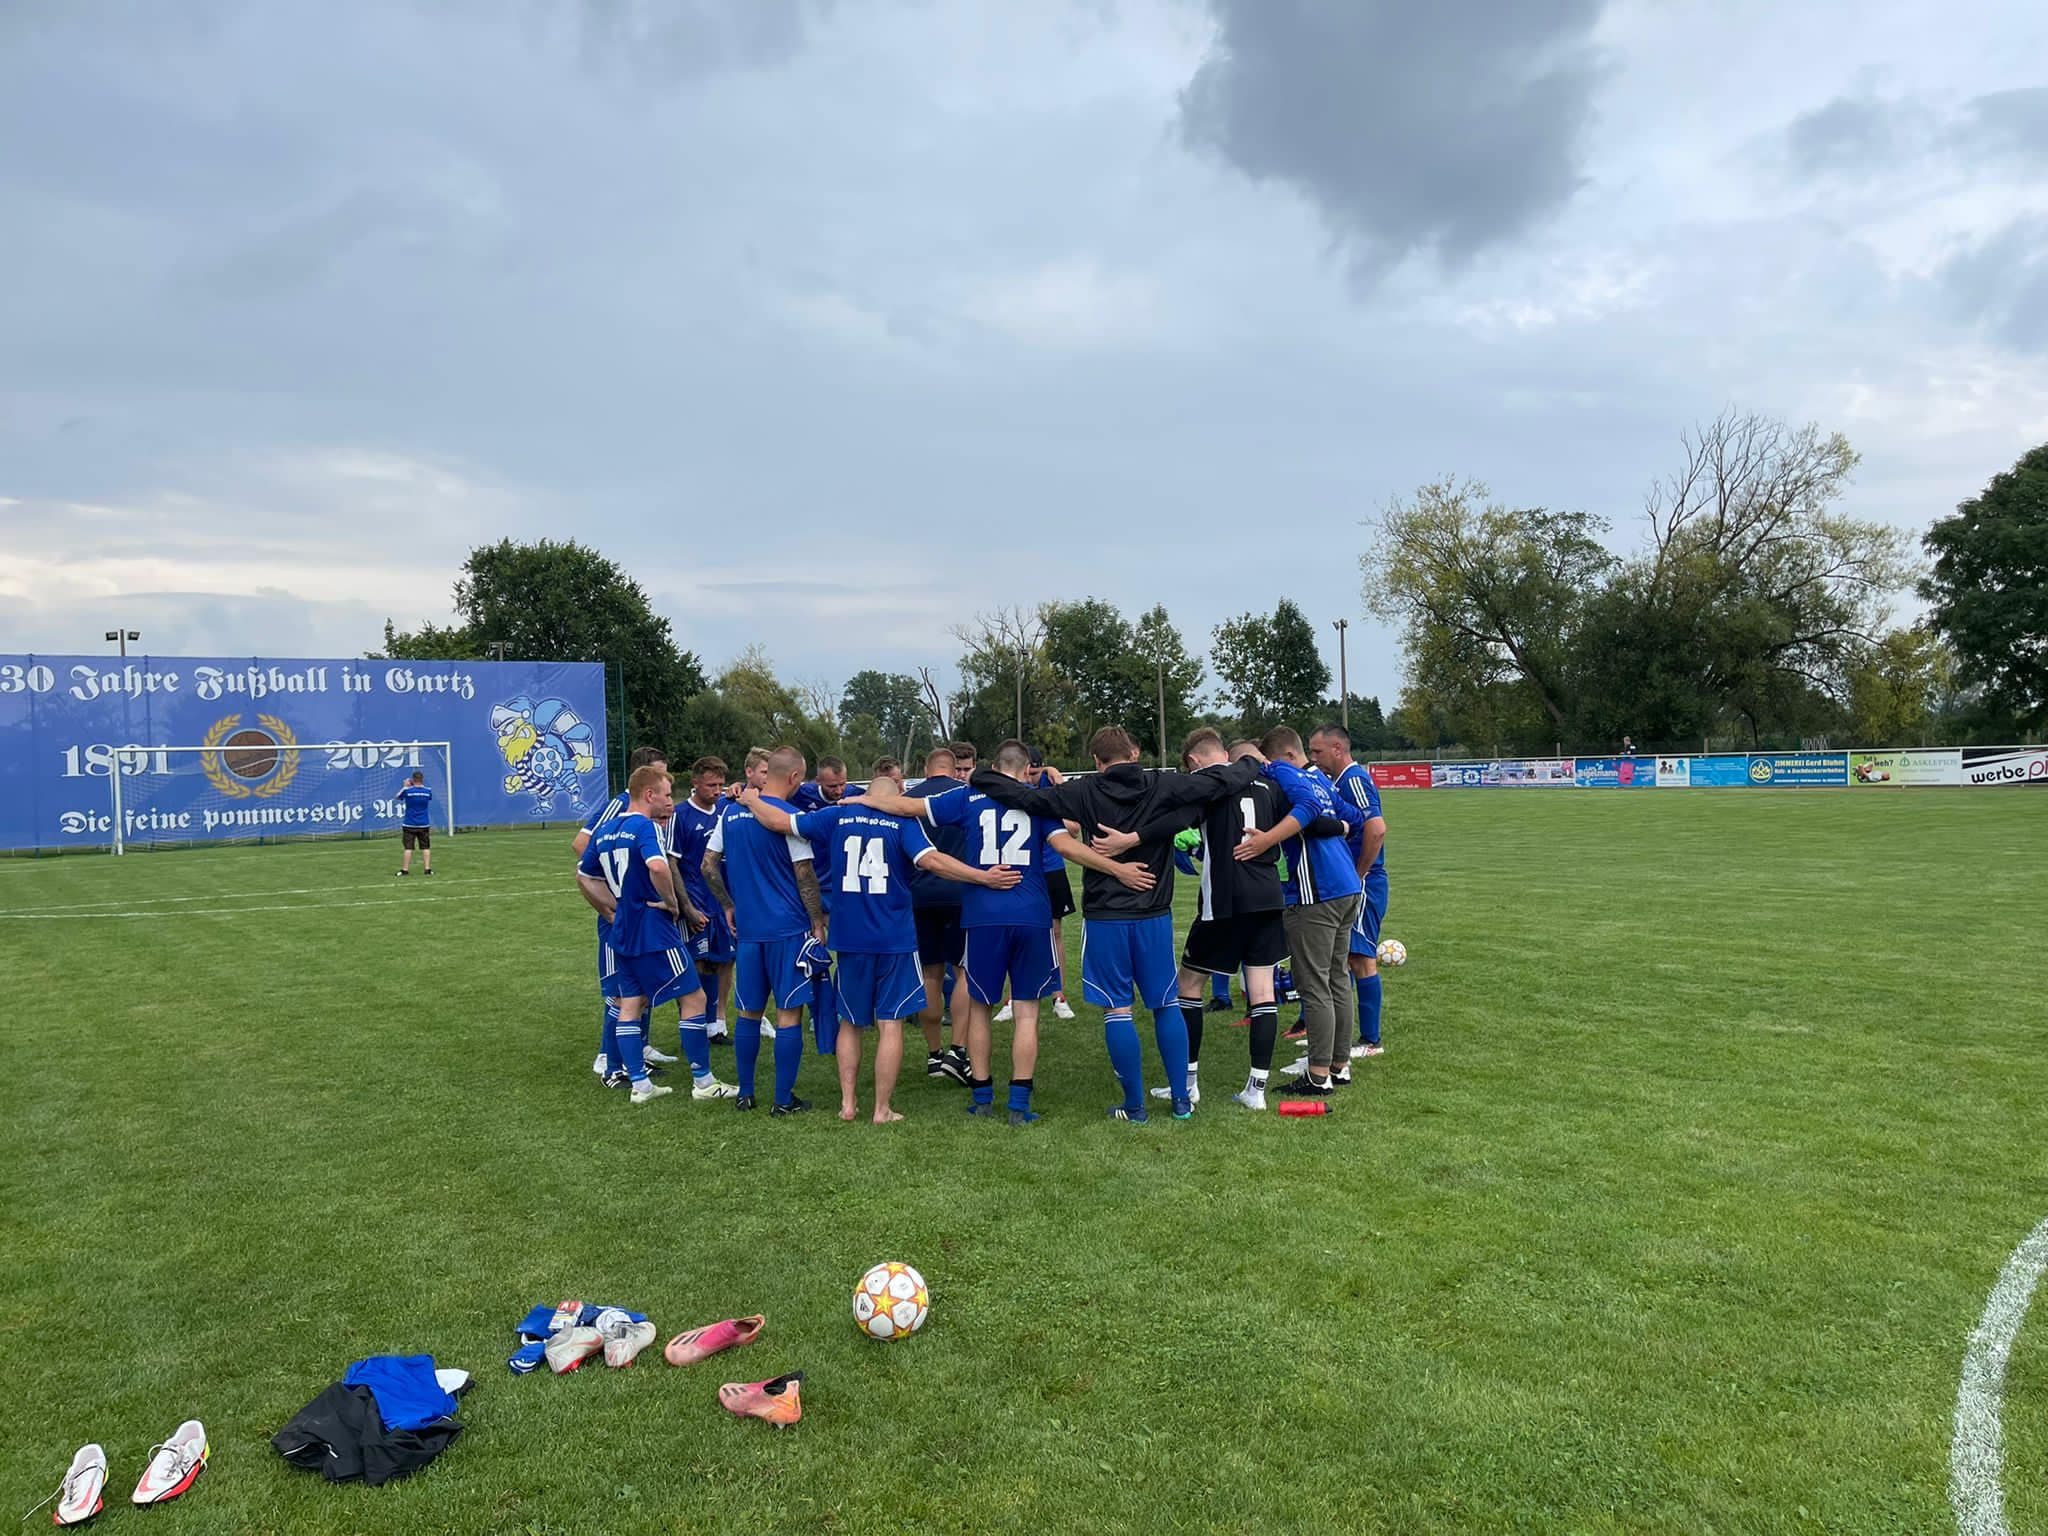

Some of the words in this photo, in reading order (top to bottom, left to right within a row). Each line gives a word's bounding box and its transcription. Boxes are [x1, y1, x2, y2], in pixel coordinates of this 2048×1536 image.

[0, 665, 55, 693] 30
[69, 664, 180, 700] Jahre
[194, 665, 328, 701] Fußball
[342, 665, 375, 693] in
[385, 667, 475, 700] Gartz
[60, 743, 175, 777] 1891
[324, 739, 425, 770] 2021
[1971, 765, 2025, 784] werbe
[60, 809, 112, 834] Die
[125, 807, 191, 837] feine
[203, 800, 363, 834] pommersche
[373, 799, 406, 818] Ar
[979, 809, 1031, 866] 12
[1240, 797, 1257, 843] 1
[599, 847, 630, 898] 17
[842, 835, 889, 895] 14
